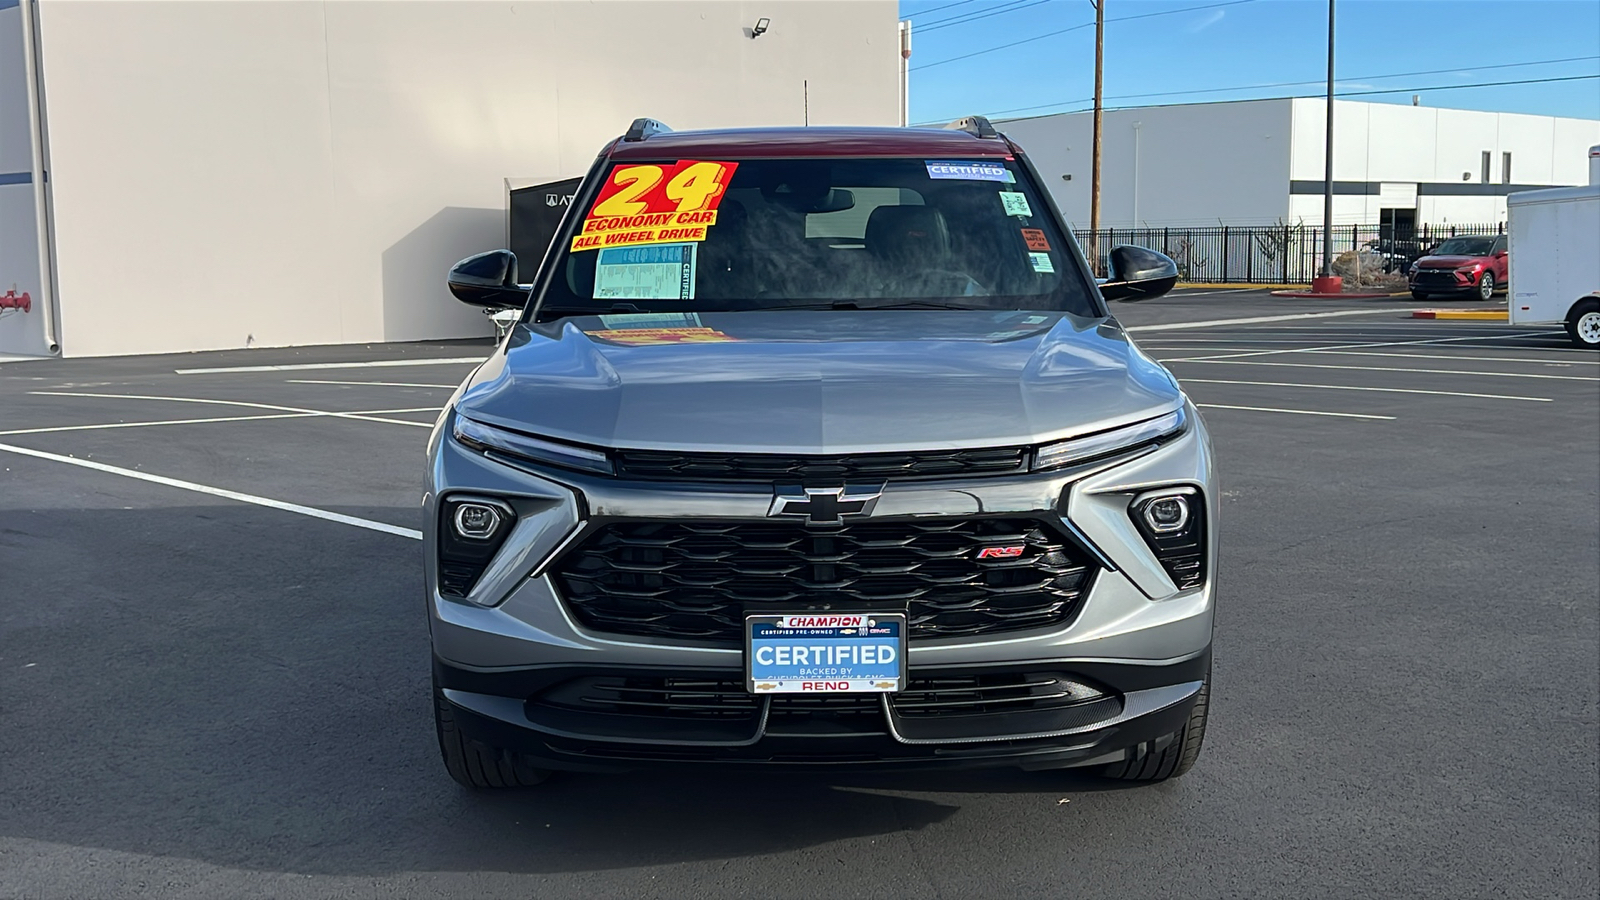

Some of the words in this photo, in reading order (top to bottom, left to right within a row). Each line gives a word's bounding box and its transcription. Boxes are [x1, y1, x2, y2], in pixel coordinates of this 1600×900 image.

[931, 165, 1004, 176] CERTIFIED
[593, 162, 726, 218] 24
[584, 213, 676, 233] ECONOMY
[676, 211, 715, 224] CAR
[573, 236, 600, 249] ALL
[605, 231, 655, 245] WHEEL
[658, 227, 704, 239] DRIVE
[977, 546, 1025, 558] RS
[789, 617, 861, 627] CHAMPION
[756, 645, 896, 665] CERTIFIED
[802, 682, 849, 690] RENO
